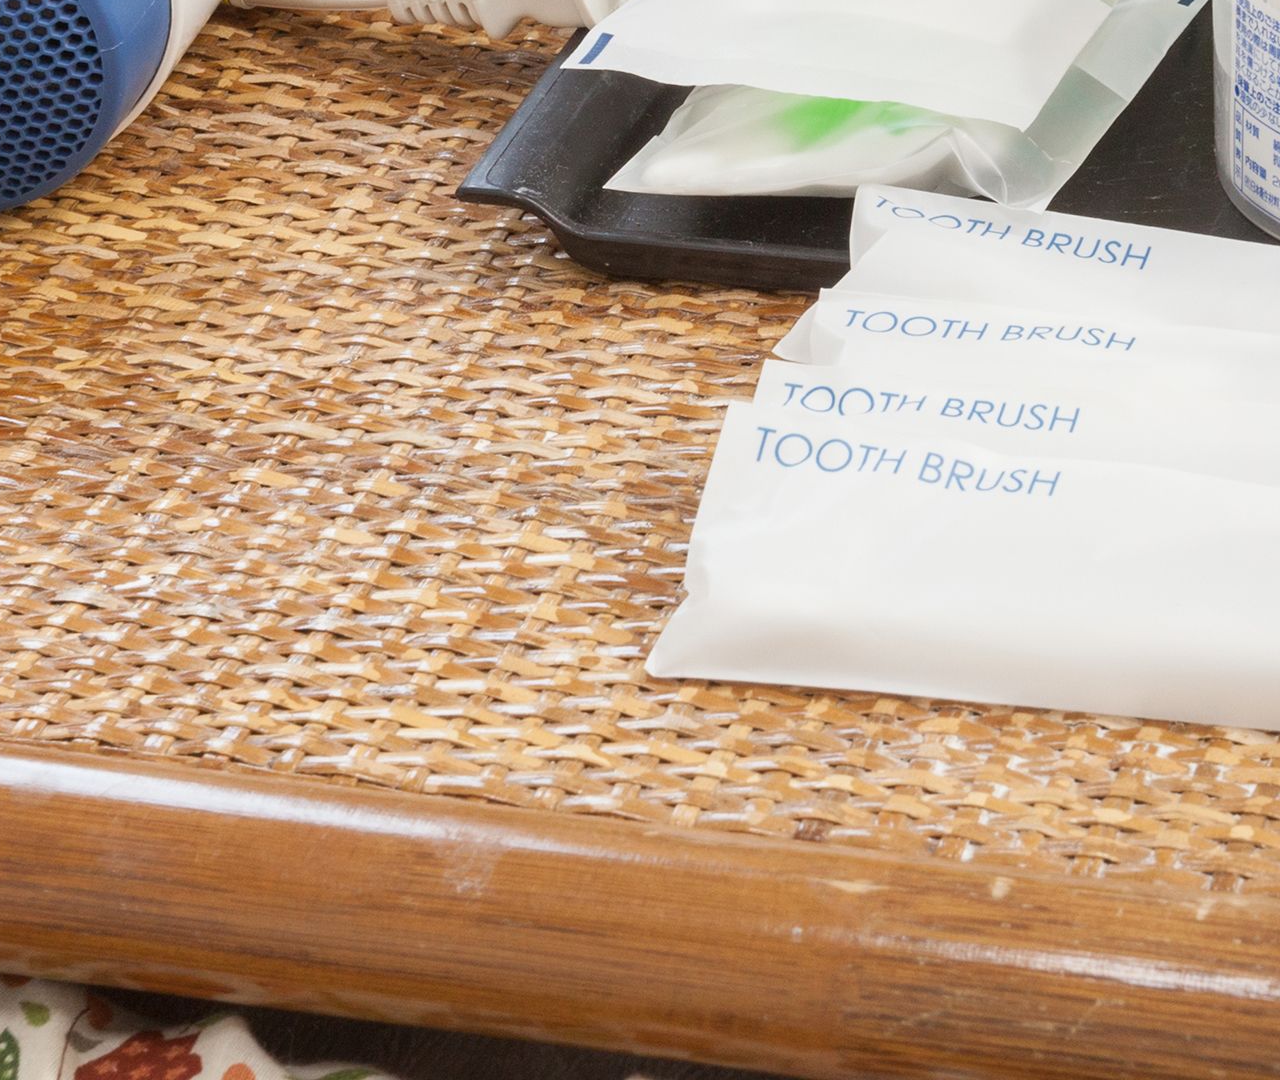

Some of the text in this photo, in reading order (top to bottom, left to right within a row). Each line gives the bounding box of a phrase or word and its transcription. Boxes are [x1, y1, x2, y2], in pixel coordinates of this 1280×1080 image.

[874, 195, 1152, 270] TOOTH BRUSH
[845, 309, 1136, 352] TOOTH BRUSH
[783, 382, 1080, 434] TOOTH BRUSH
[756, 426, 1061, 497] TOOTH BRUSH
